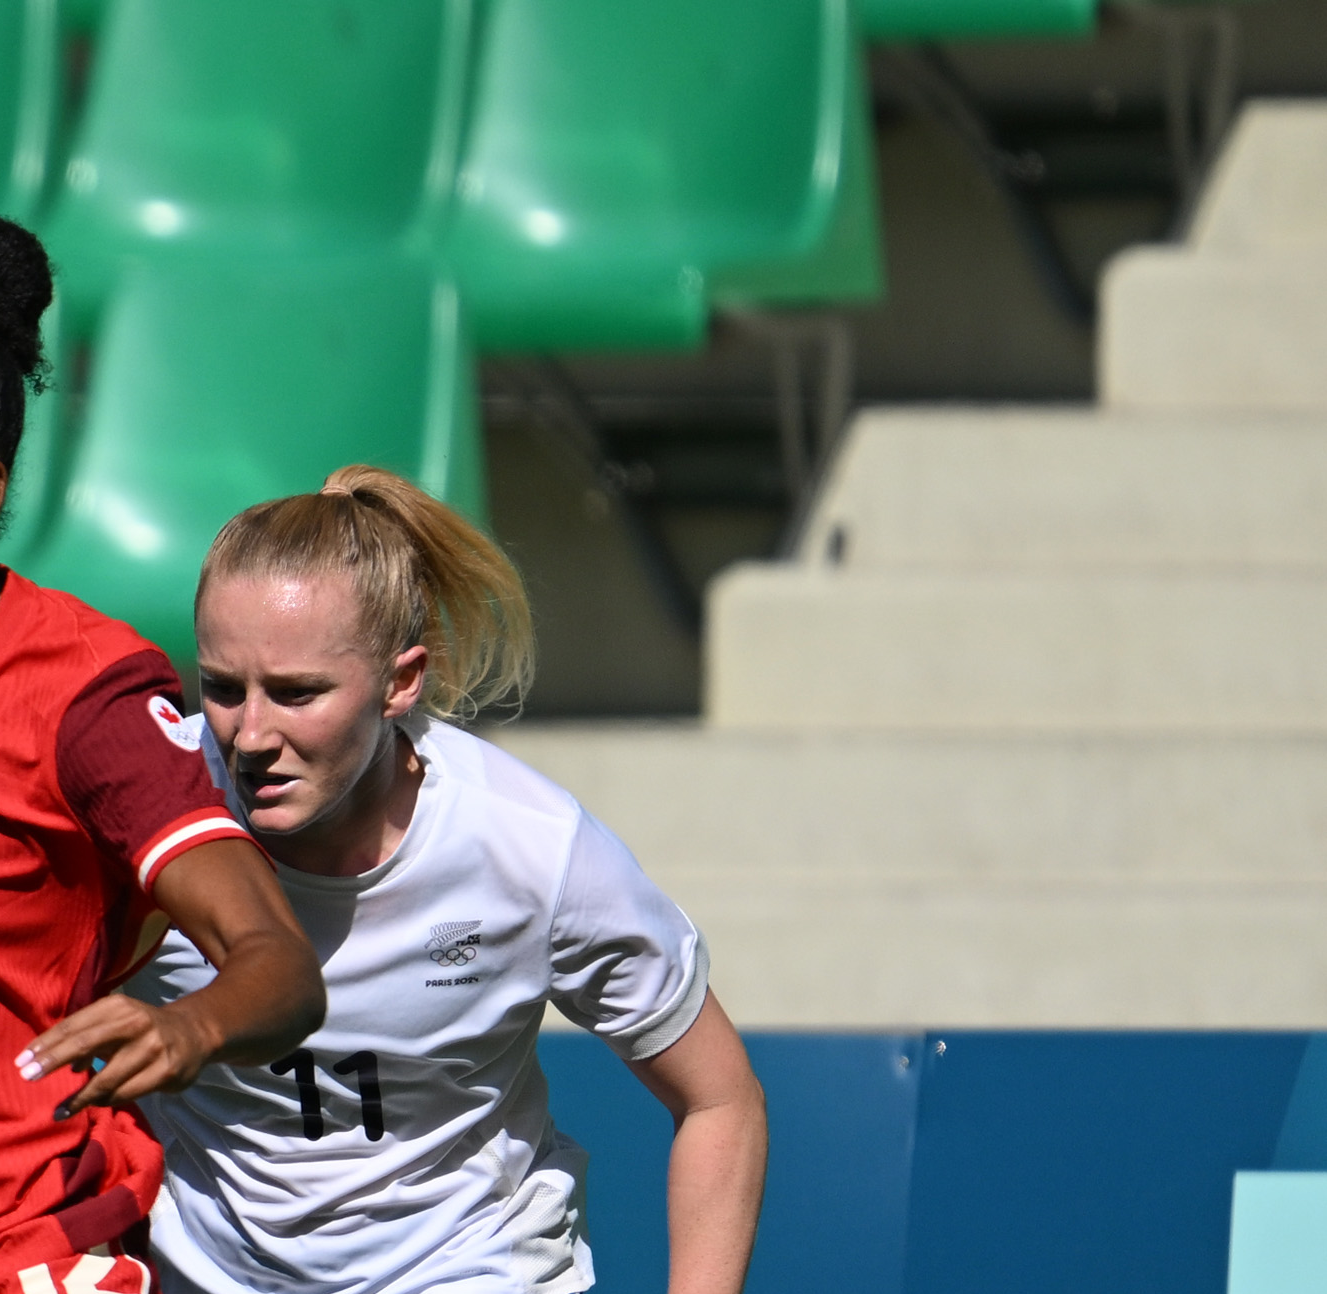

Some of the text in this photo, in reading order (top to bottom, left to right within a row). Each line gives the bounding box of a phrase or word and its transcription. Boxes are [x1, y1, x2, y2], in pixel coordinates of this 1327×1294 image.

[425, 976, 479, 988] PARIS 2024
[270, 1048, 384, 1141] 11
